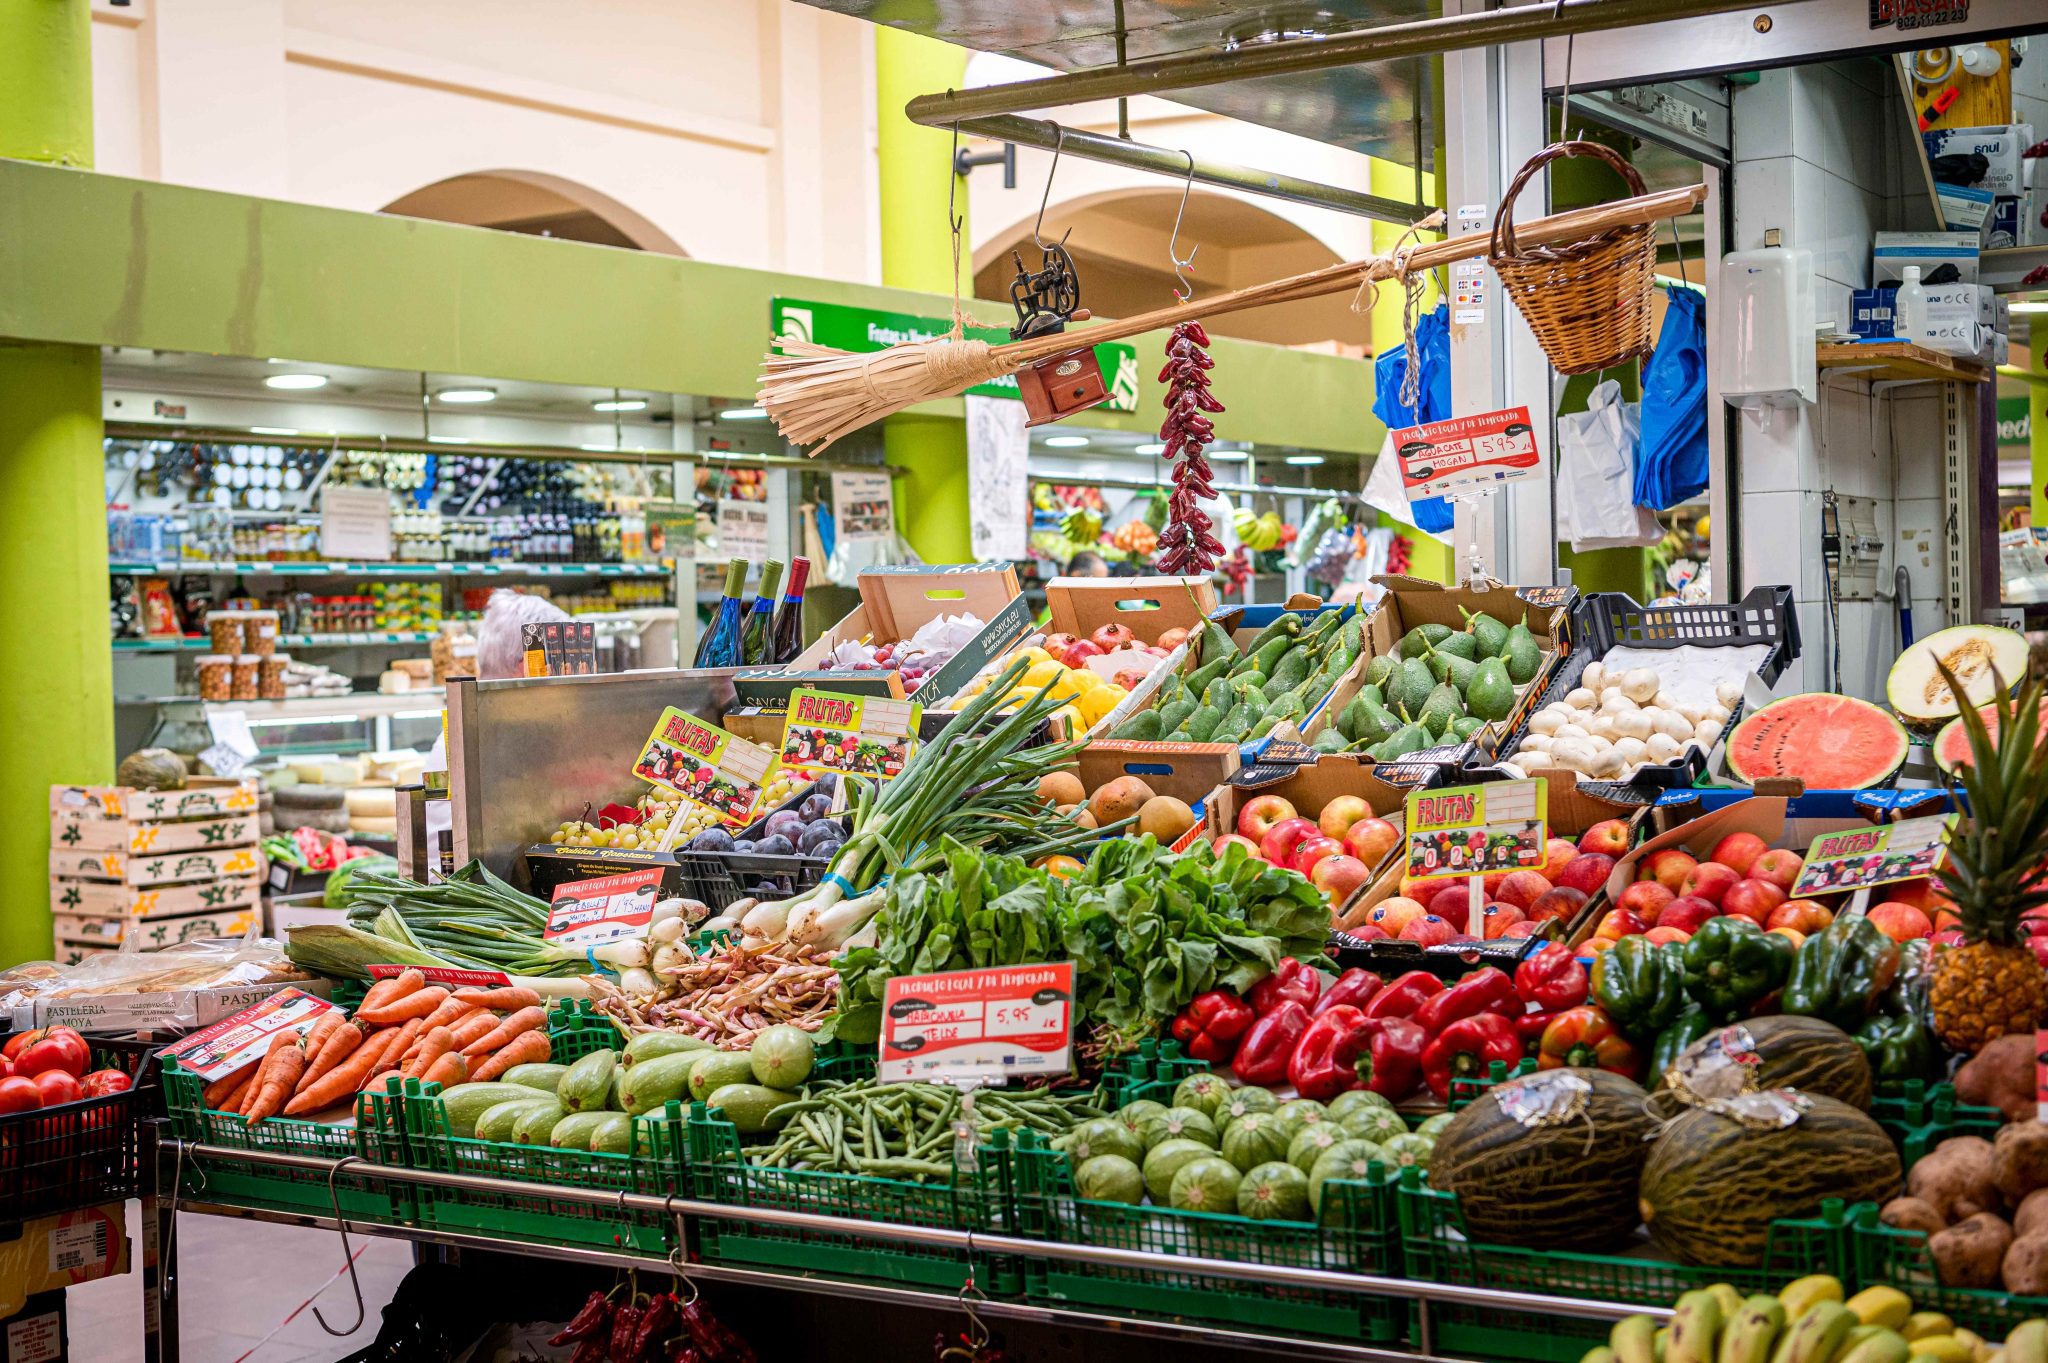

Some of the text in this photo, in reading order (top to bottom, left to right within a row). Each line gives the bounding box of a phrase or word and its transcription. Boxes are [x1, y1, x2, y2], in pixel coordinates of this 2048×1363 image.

[1478, 412, 1519, 427] TEMPORADA
[1418, 442, 1464, 459] AGUACATE
[798, 695, 854, 726] FRUTAS
[663, 715, 720, 757] FRUTAS
[1092, 740, 1192, 751] PREMIUM SELECTION
[1416, 793, 1475, 826] FRUTAS
[555, 847, 656, 860] Calidad Constante
[1816, 830, 1882, 860] FRUTAS
[900, 979, 945, 995] PRODUCTO
[1001, 970, 1057, 987] TEMPORADA
[62, 1018, 93, 1027] MOYA
[922, 1026, 959, 1041] TELDE
